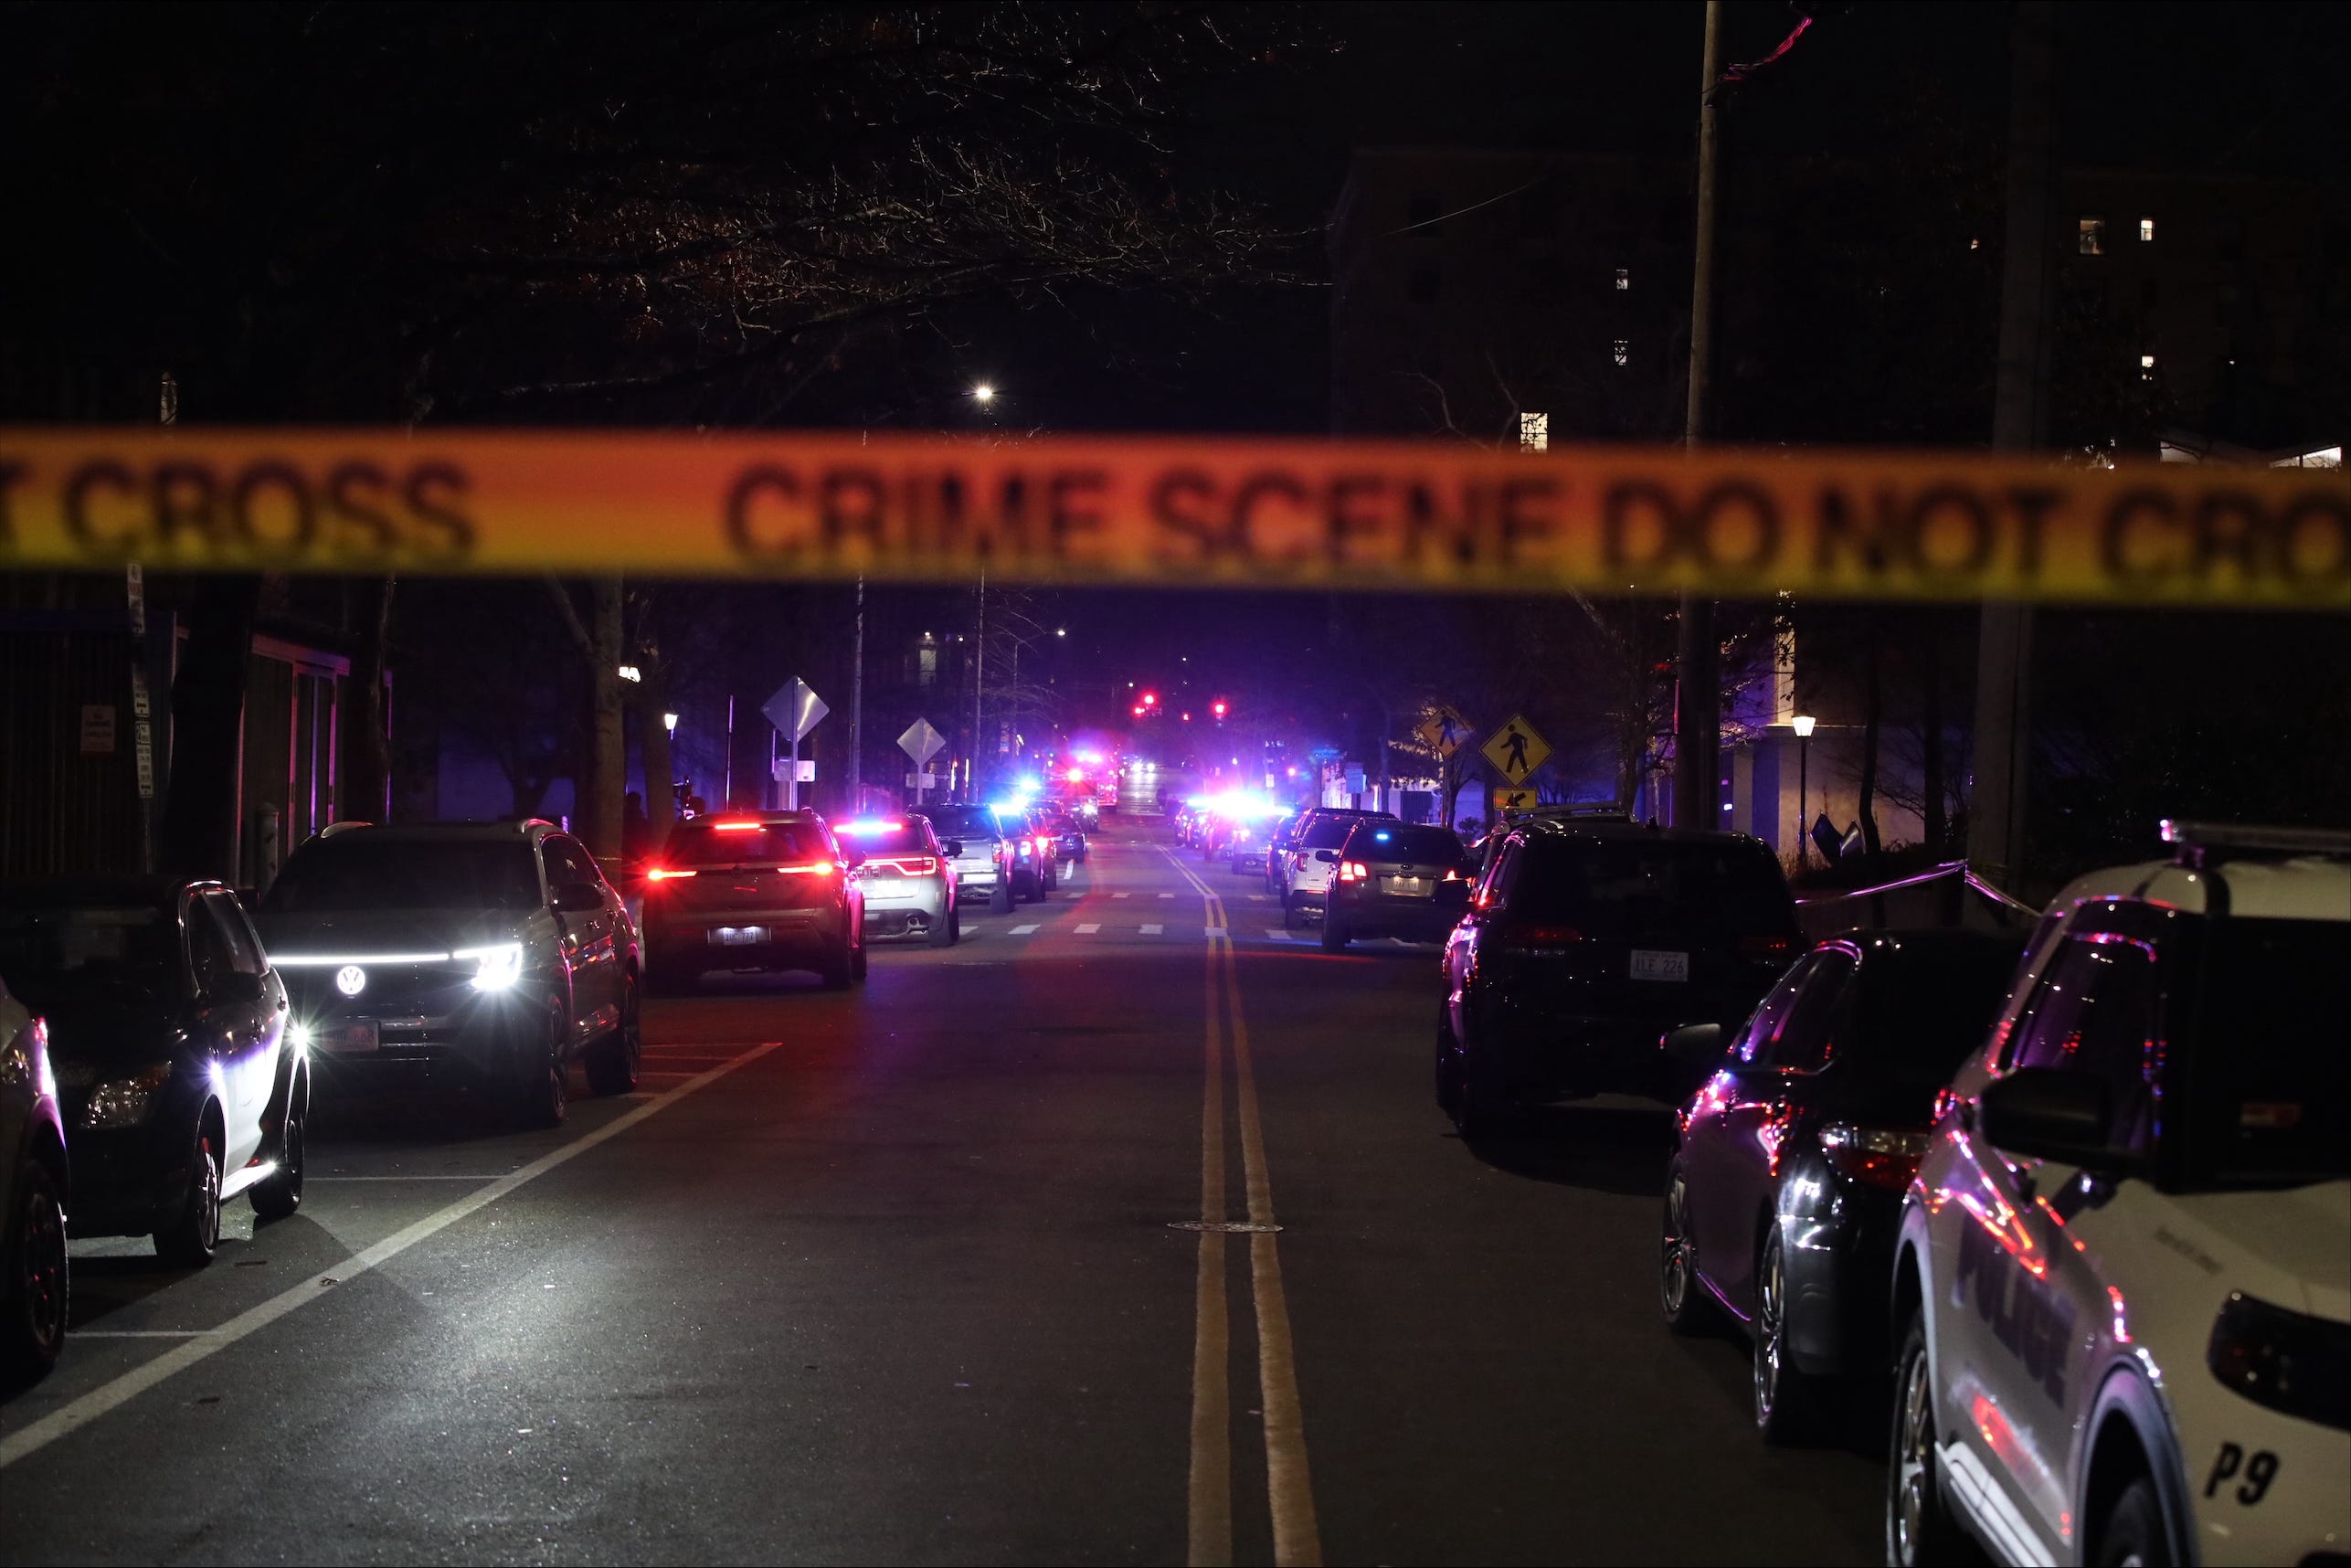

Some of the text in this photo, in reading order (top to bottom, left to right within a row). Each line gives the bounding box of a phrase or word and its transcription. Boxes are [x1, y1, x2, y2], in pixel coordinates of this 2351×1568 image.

[62, 459, 475, 564] CROSS
[723, 464, 1107, 573] CRIME
[1149, 468, 1557, 577] SCENE
[1603, 475, 1778, 584] DO
[1819, 481, 2060, 590] NOT
[1663, 959, 1684, 974] 226
[2205, 1441, 2281, 1507] P9
